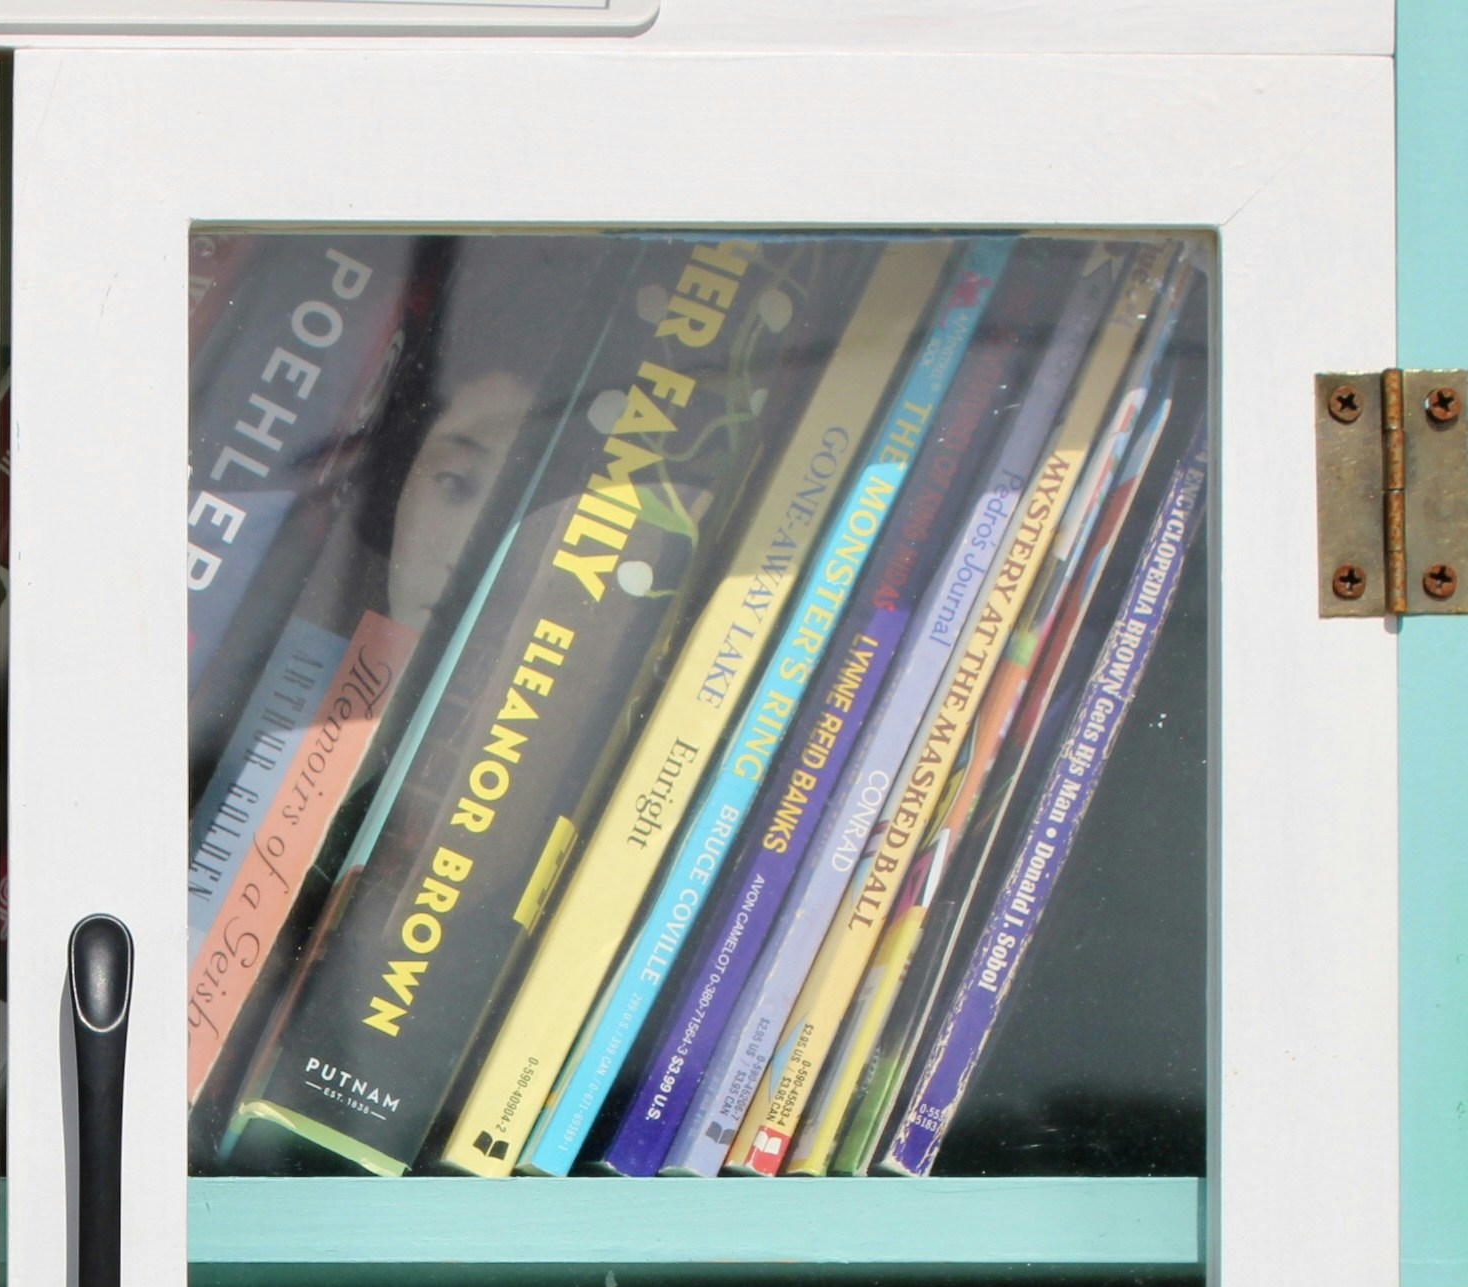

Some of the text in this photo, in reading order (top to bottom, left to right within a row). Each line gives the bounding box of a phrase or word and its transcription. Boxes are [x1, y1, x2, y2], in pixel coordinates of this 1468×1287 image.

[880, 401, 932, 472] THE
[552, 361, 696, 602] FAMILY
[972, 469, 1024, 550] Pedro's
[994, 450, 1070, 604] MYSTERY
[1133, 468, 1205, 615] ENCYCLOPEDIA
[696, 425, 849, 710] GONE-AWAY LAKE
[779, 474, 894, 684] MONSTER'S
[929, 552, 984, 647] Journal
[975, 603, 1003, 645] AT
[1102, 617, 1148, 697] BROWN
[826, 633, 879, 713] LYNNE
[943, 650, 989, 713] THE
[735, 689, 792, 781] RING
[802, 711, 844, 769] REID
[1068, 741, 1097, 779] His
[1083, 697, 1114, 743] Gets
[188, 651, 326, 902] ARTHUR GOLDEN
[627, 736, 699, 851] Enright
[762, 769, 817, 854] BANKS
[884, 714, 958, 851] MASKED
[1048, 776, 1083, 824] Man
[188, 645, 393, 1040] Memoirs of a Geish
[362, 618, 576, 1038] ELEANOR BROWN
[831, 770, 890, 872] CONRAD
[640, 803, 741, 986] BRUCE COVILLE
[848, 850, 899, 931] BALL
[1016, 840, 1055, 916] Donald
[645, 873, 765, 1121] AVON CAMELOT 0-380-71564-3 $3.99 U.S.
[977, 928, 1017, 994] Sobol
[305, 1057, 401, 1113] PUTNAM
[745, 1043, 760, 1058] US
[791, 1050, 805, 1063] US
[323, 1087, 370, 1115] EST. 1838
[496, 1057, 539, 1133] 0-590-40904-2
[719, 1094, 735, 1117] CAN
[766, 1101, 782, 1122] CAN
